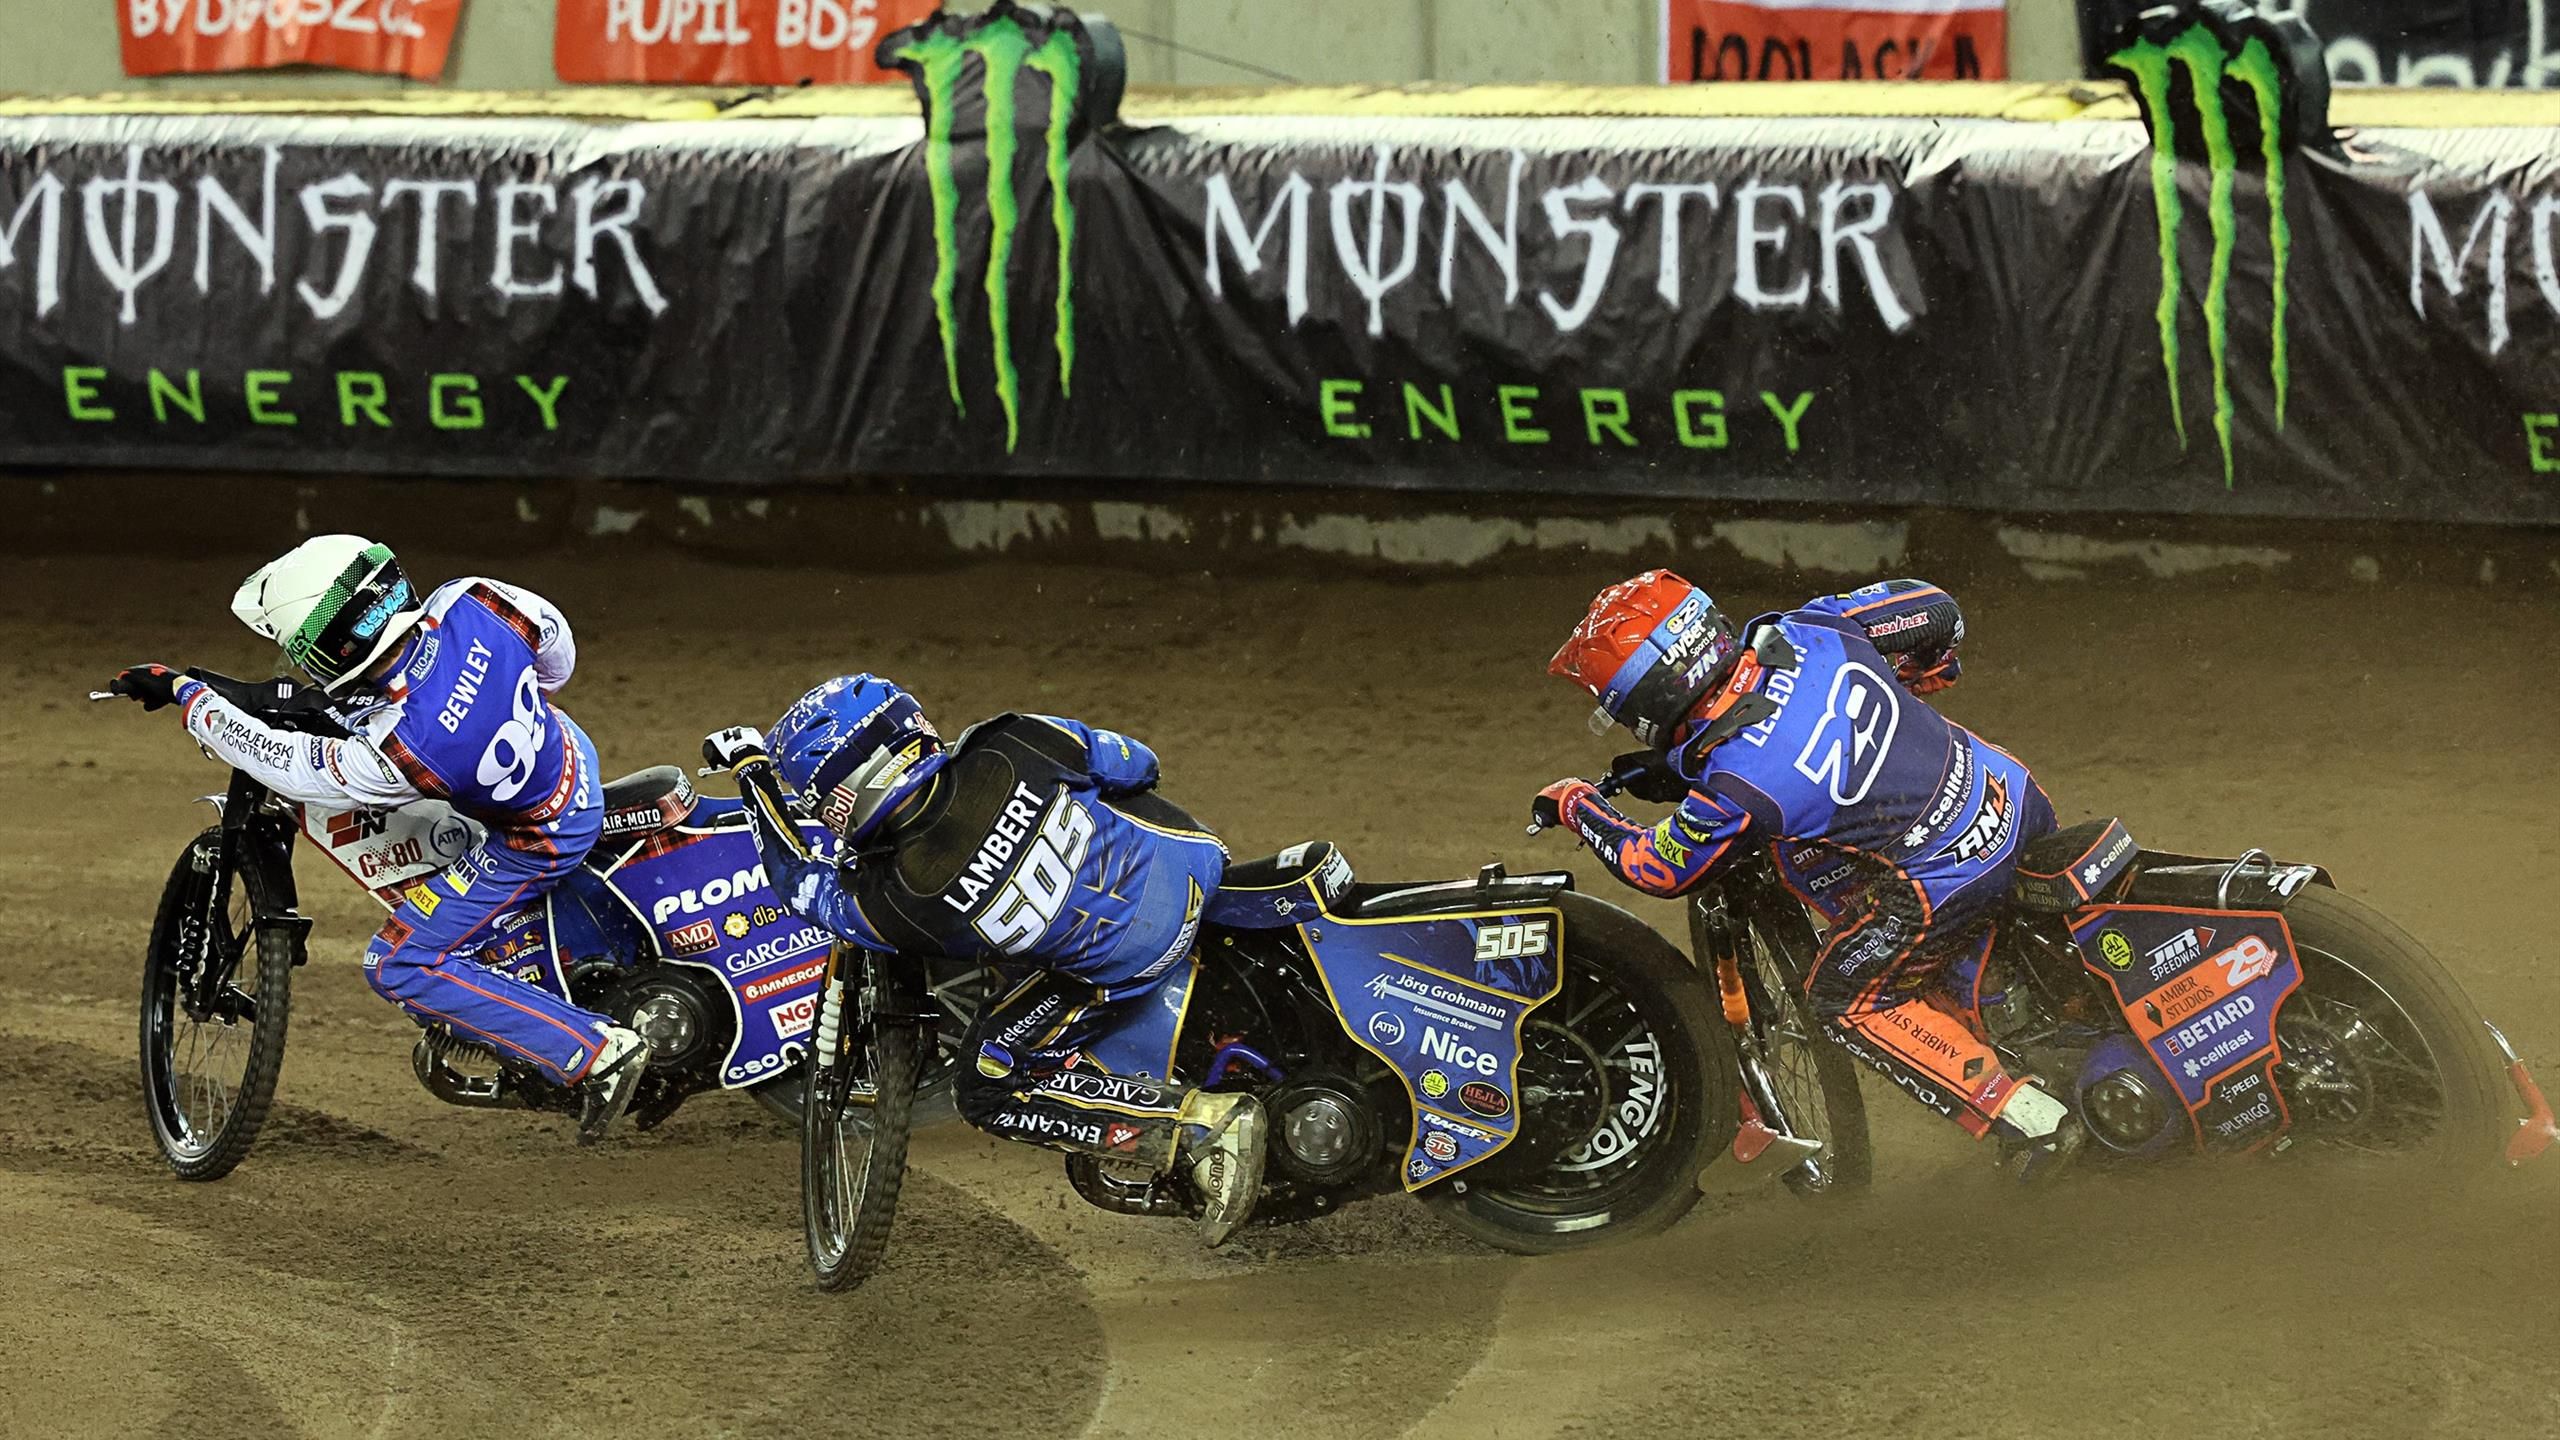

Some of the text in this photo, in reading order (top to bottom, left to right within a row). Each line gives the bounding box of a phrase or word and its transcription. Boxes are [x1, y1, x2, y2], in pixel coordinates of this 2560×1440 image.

[0, 145, 668, 325] MONSTER
[1205, 143, 1913, 337] MONSTER
[64, 367, 569, 431] ENERGY
[1320, 380, 1814, 453] ENERGY
[346, 695, 375, 706] #99
[437, 638, 494, 735] BEWLEY
[221, 732, 293, 773] KONSTRUKCJE
[225, 718, 295, 760] KRAJEWSKI
[476, 665, 548, 802] 99
[1928, 739, 1966, 827] cellfast
[437, 826, 465, 847] ATPI
[602, 808, 661, 831] AIR-MOTO
[1938, 800, 1966, 832] GARDEN
[1986, 800, 2014, 853] BETARD
[943, 780, 1045, 914] LAMBERT
[971, 783, 1097, 957] 505
[671, 923, 713, 947] AMD
[1474, 920, 1550, 962] 505
[2151, 944, 2201, 982] SPEEDWAY
[2215, 937, 2268, 987] 29
[1396, 973, 1507, 1019] Jörg Grohmann
[2158, 975, 2199, 1006] AMBER
[2165, 985, 2216, 1021] STUDIOS
[1374, 1020, 1399, 1036] ATPI
[1412, 1005, 1478, 1032] Insurance Broker
[2178, 995, 2256, 1049] BETARD
[1419, 1025, 1499, 1076] Nice
[1910, 1024, 1962, 1060] AMBER
[2200, 1028, 2255, 1067] cellfast
[1465, 1085, 1506, 1108] HEJLA
[1427, 1138, 1453, 1154] STS
